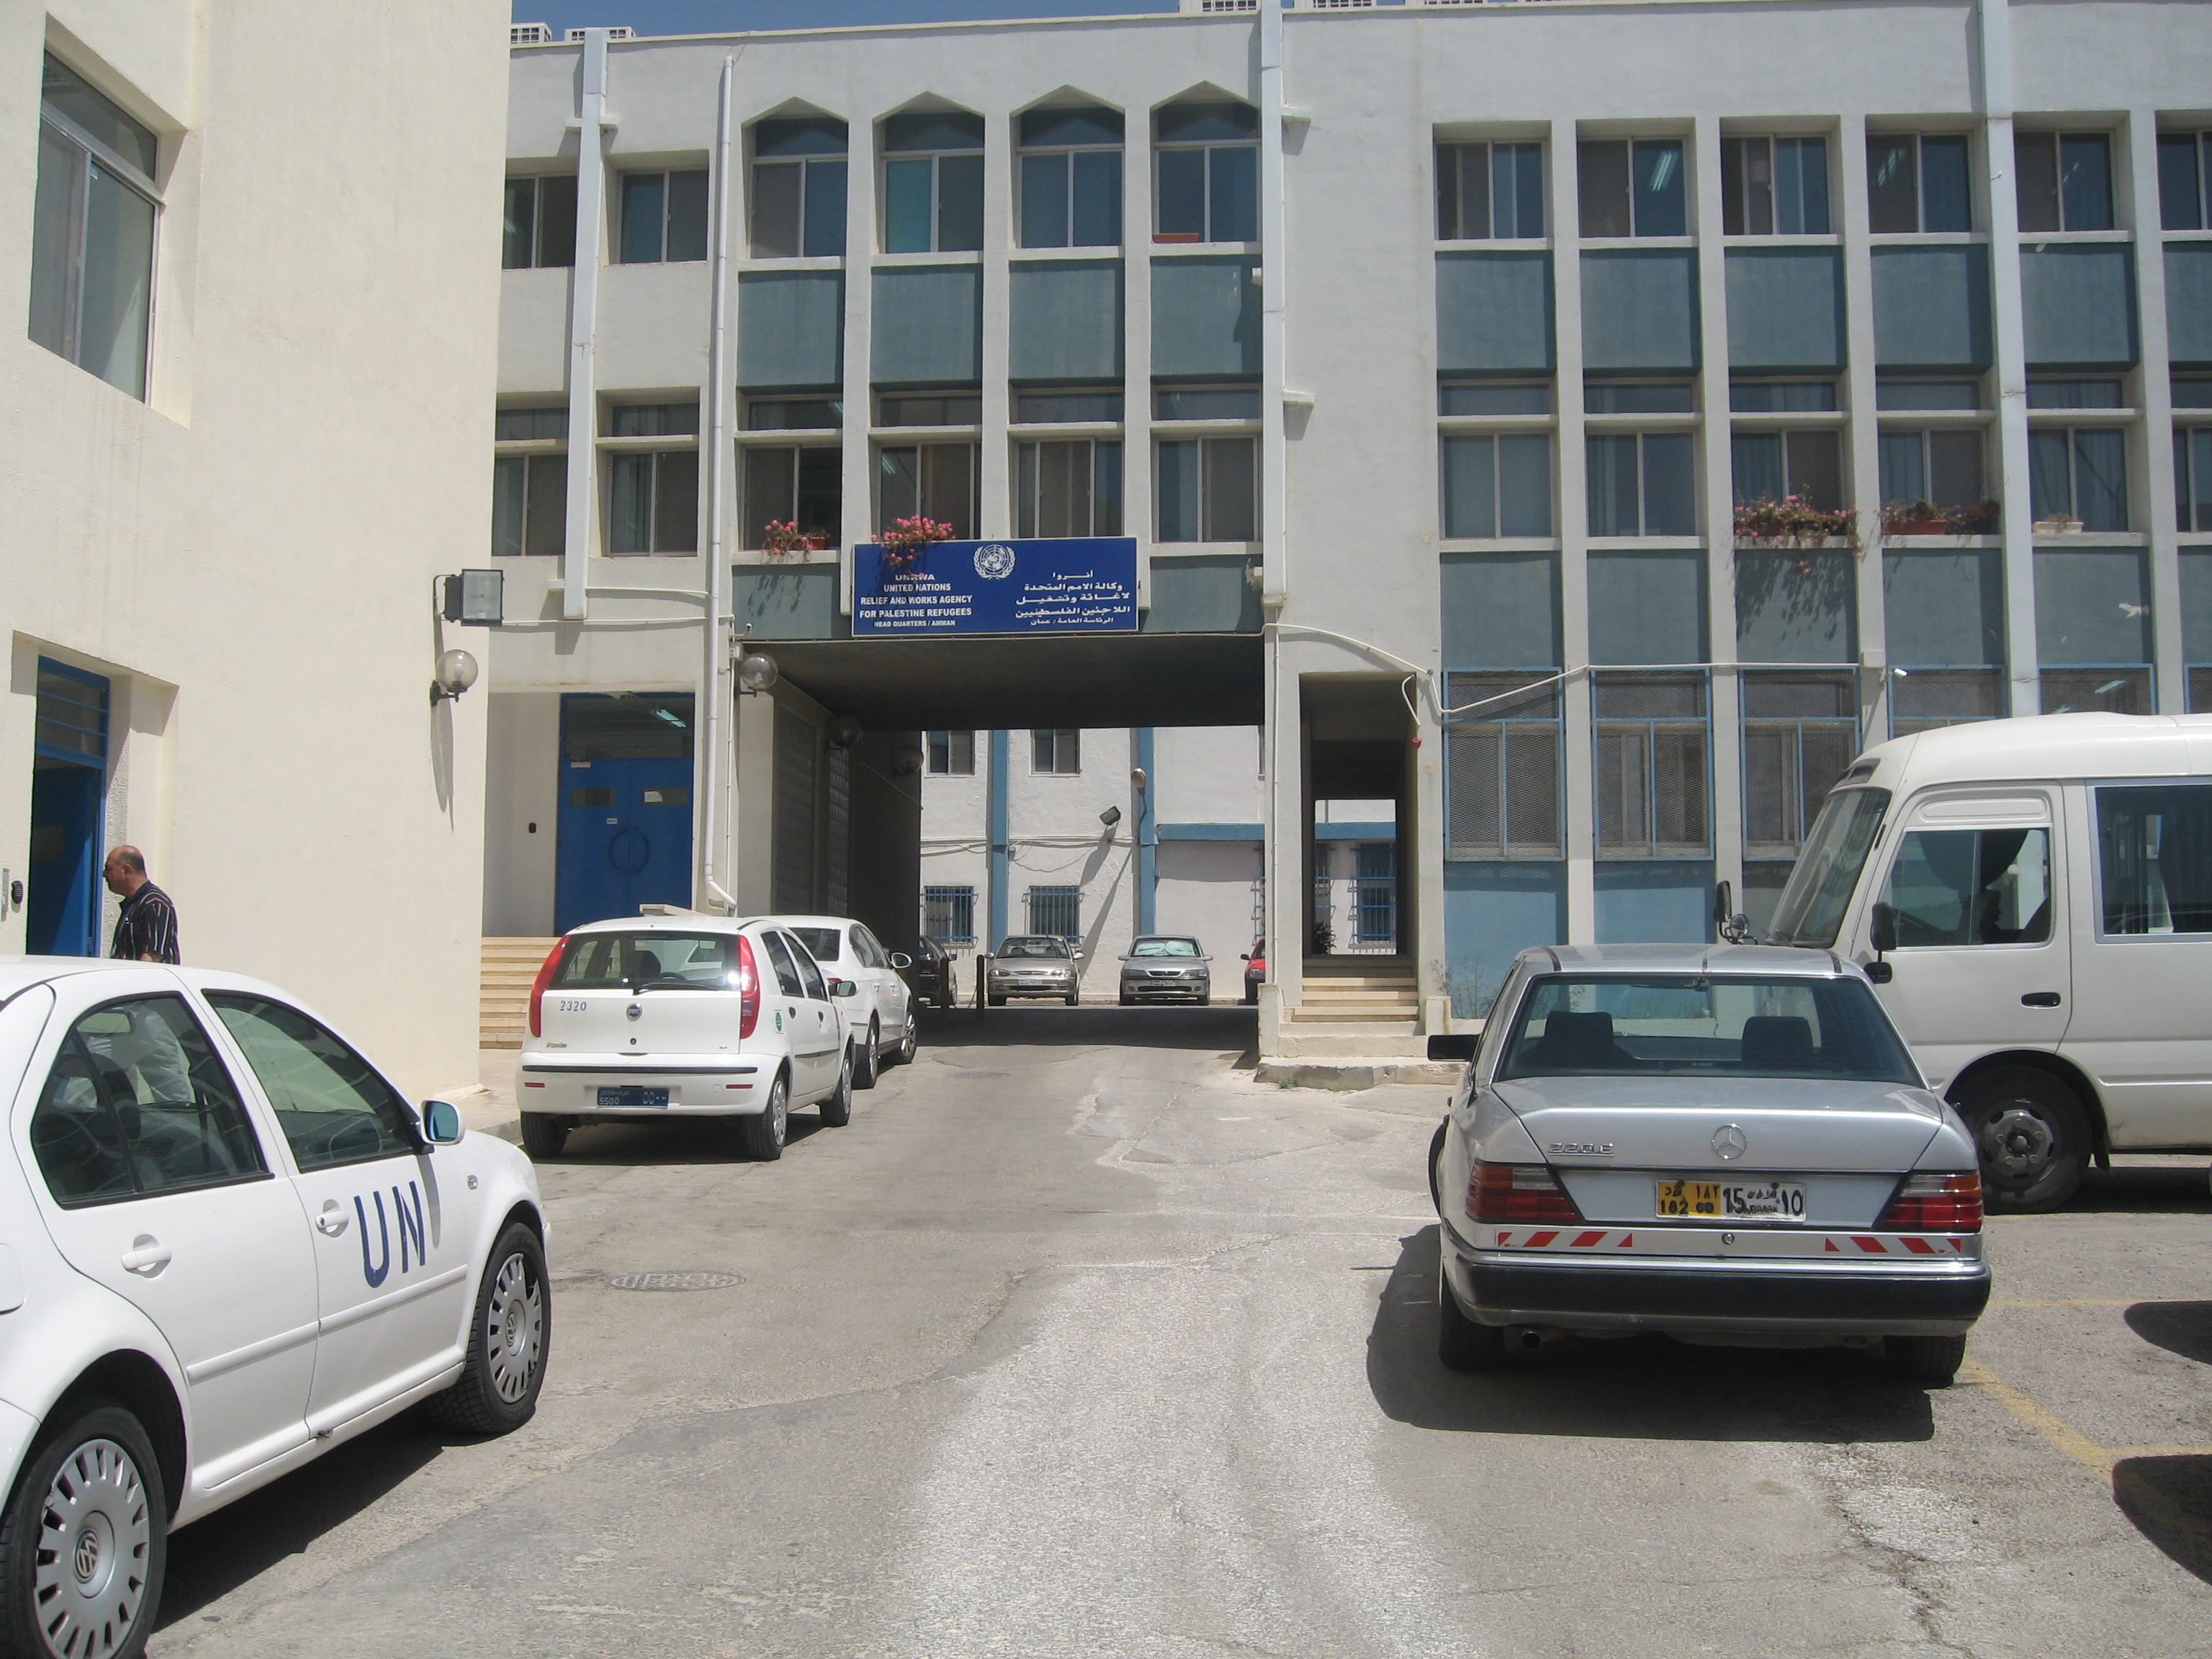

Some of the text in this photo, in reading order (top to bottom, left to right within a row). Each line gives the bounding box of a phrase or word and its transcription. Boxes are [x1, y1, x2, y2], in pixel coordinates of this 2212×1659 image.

[1095, 582, 1123, 591] وكالة
[860, 596, 888, 605] RELIEF
[909, 595, 938, 604] WORKS
[939, 595, 972, 603] AGENCY
[1015, 595, 1077, 605] وتشغيل
[927, 608, 972, 616] REFUGEES
[1015, 606, 1130, 618] اللاجئين الفلسطينيين
[559, 1000, 587, 1012] 2320
[598, 1096, 619, 1105] 5500
[1722, 1187, 1747, 1214] 15
[354, 1180, 426, 1289] UN
